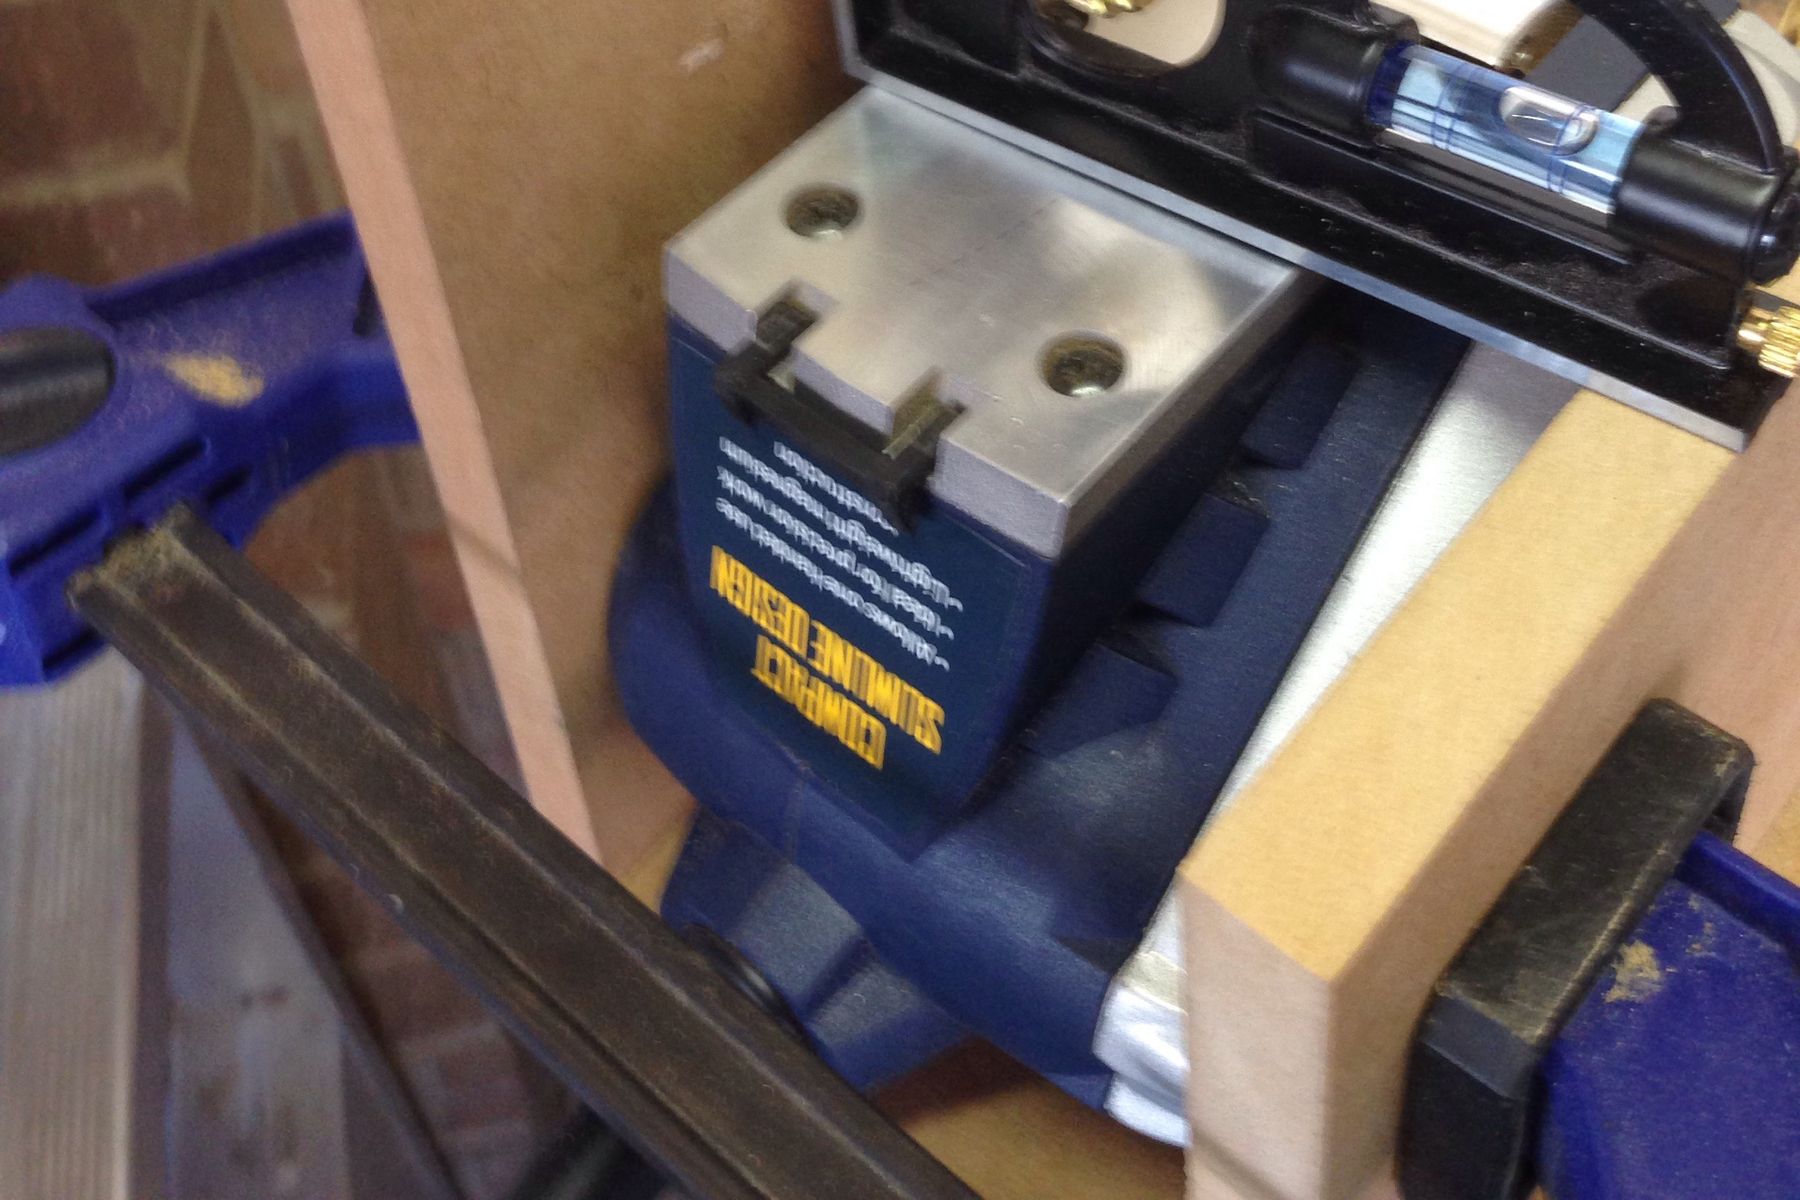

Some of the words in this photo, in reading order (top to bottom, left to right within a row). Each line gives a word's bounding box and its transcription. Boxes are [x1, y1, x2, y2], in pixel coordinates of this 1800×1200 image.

[709, 544, 811, 661] DESIGN
[864, 602, 937, 666] Allows
[751, 634, 887, 770] COMPACT
[806, 619, 946, 756] SLIMLINE
